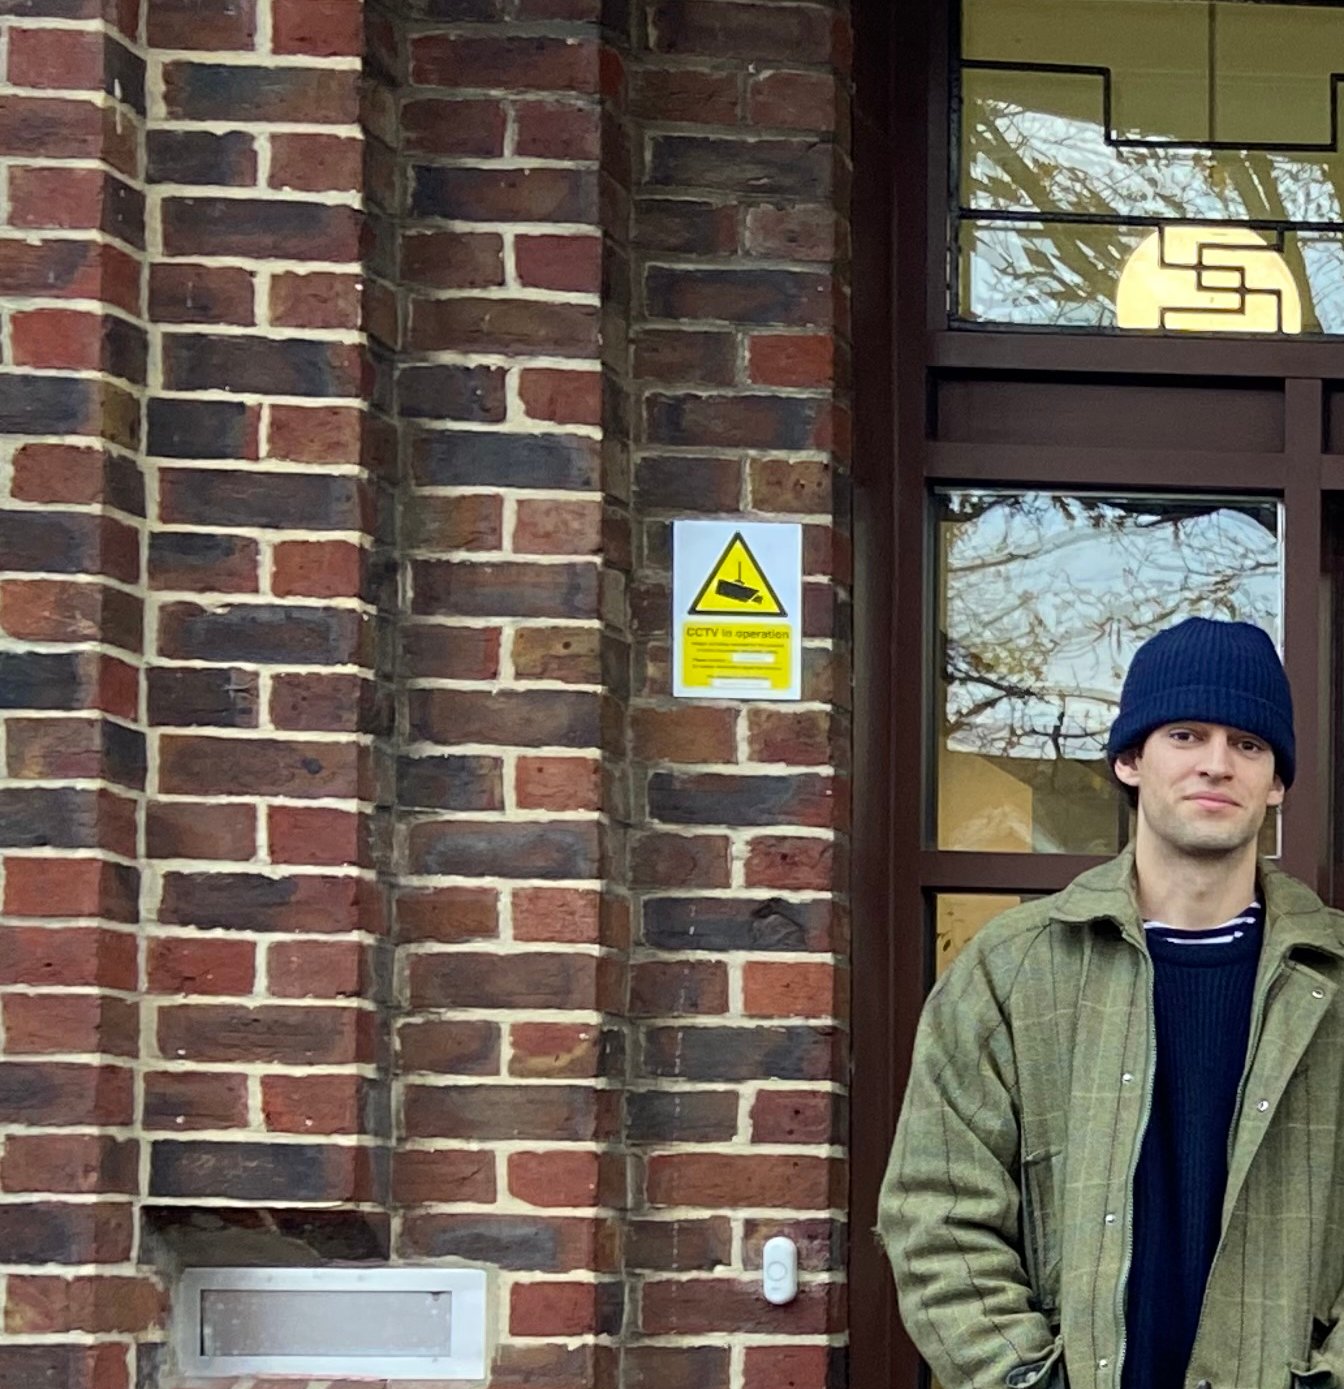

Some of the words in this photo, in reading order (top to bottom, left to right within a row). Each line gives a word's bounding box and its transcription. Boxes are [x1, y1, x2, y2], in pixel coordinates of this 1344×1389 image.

[686, 627, 719, 637] CCTV
[722, 628, 732, 638] in
[735, 629, 790, 640] operation
